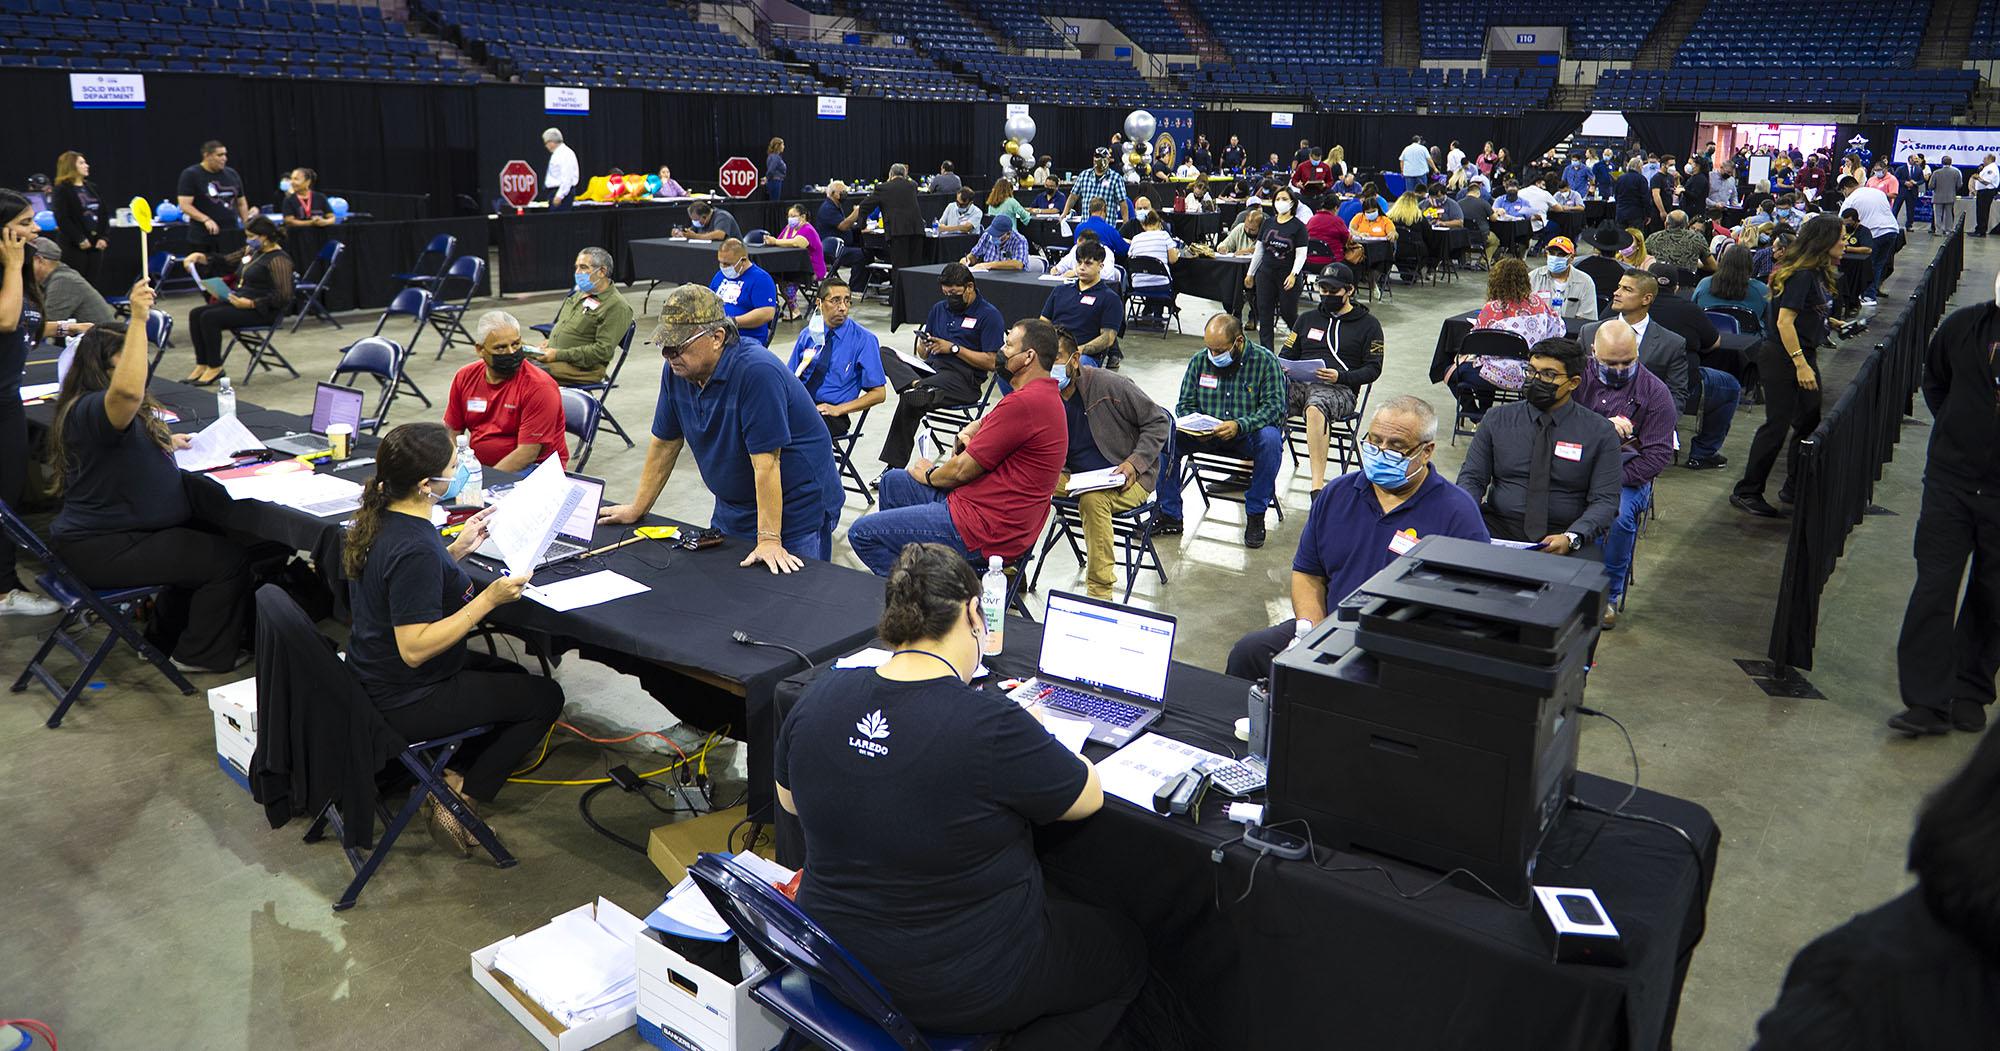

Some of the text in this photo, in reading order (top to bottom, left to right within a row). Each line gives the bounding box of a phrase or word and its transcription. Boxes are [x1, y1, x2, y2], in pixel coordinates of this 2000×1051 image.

[894, 35, 905, 44] 107
[1520, 35, 1533, 43] 110
[503, 174, 534, 192] STOP
[722, 170, 755, 186] STOP
[982, 596, 1001, 605] ovr
[849, 736, 889, 756] LAREDO
[663, 1027, 691, 1050] BANKERS
